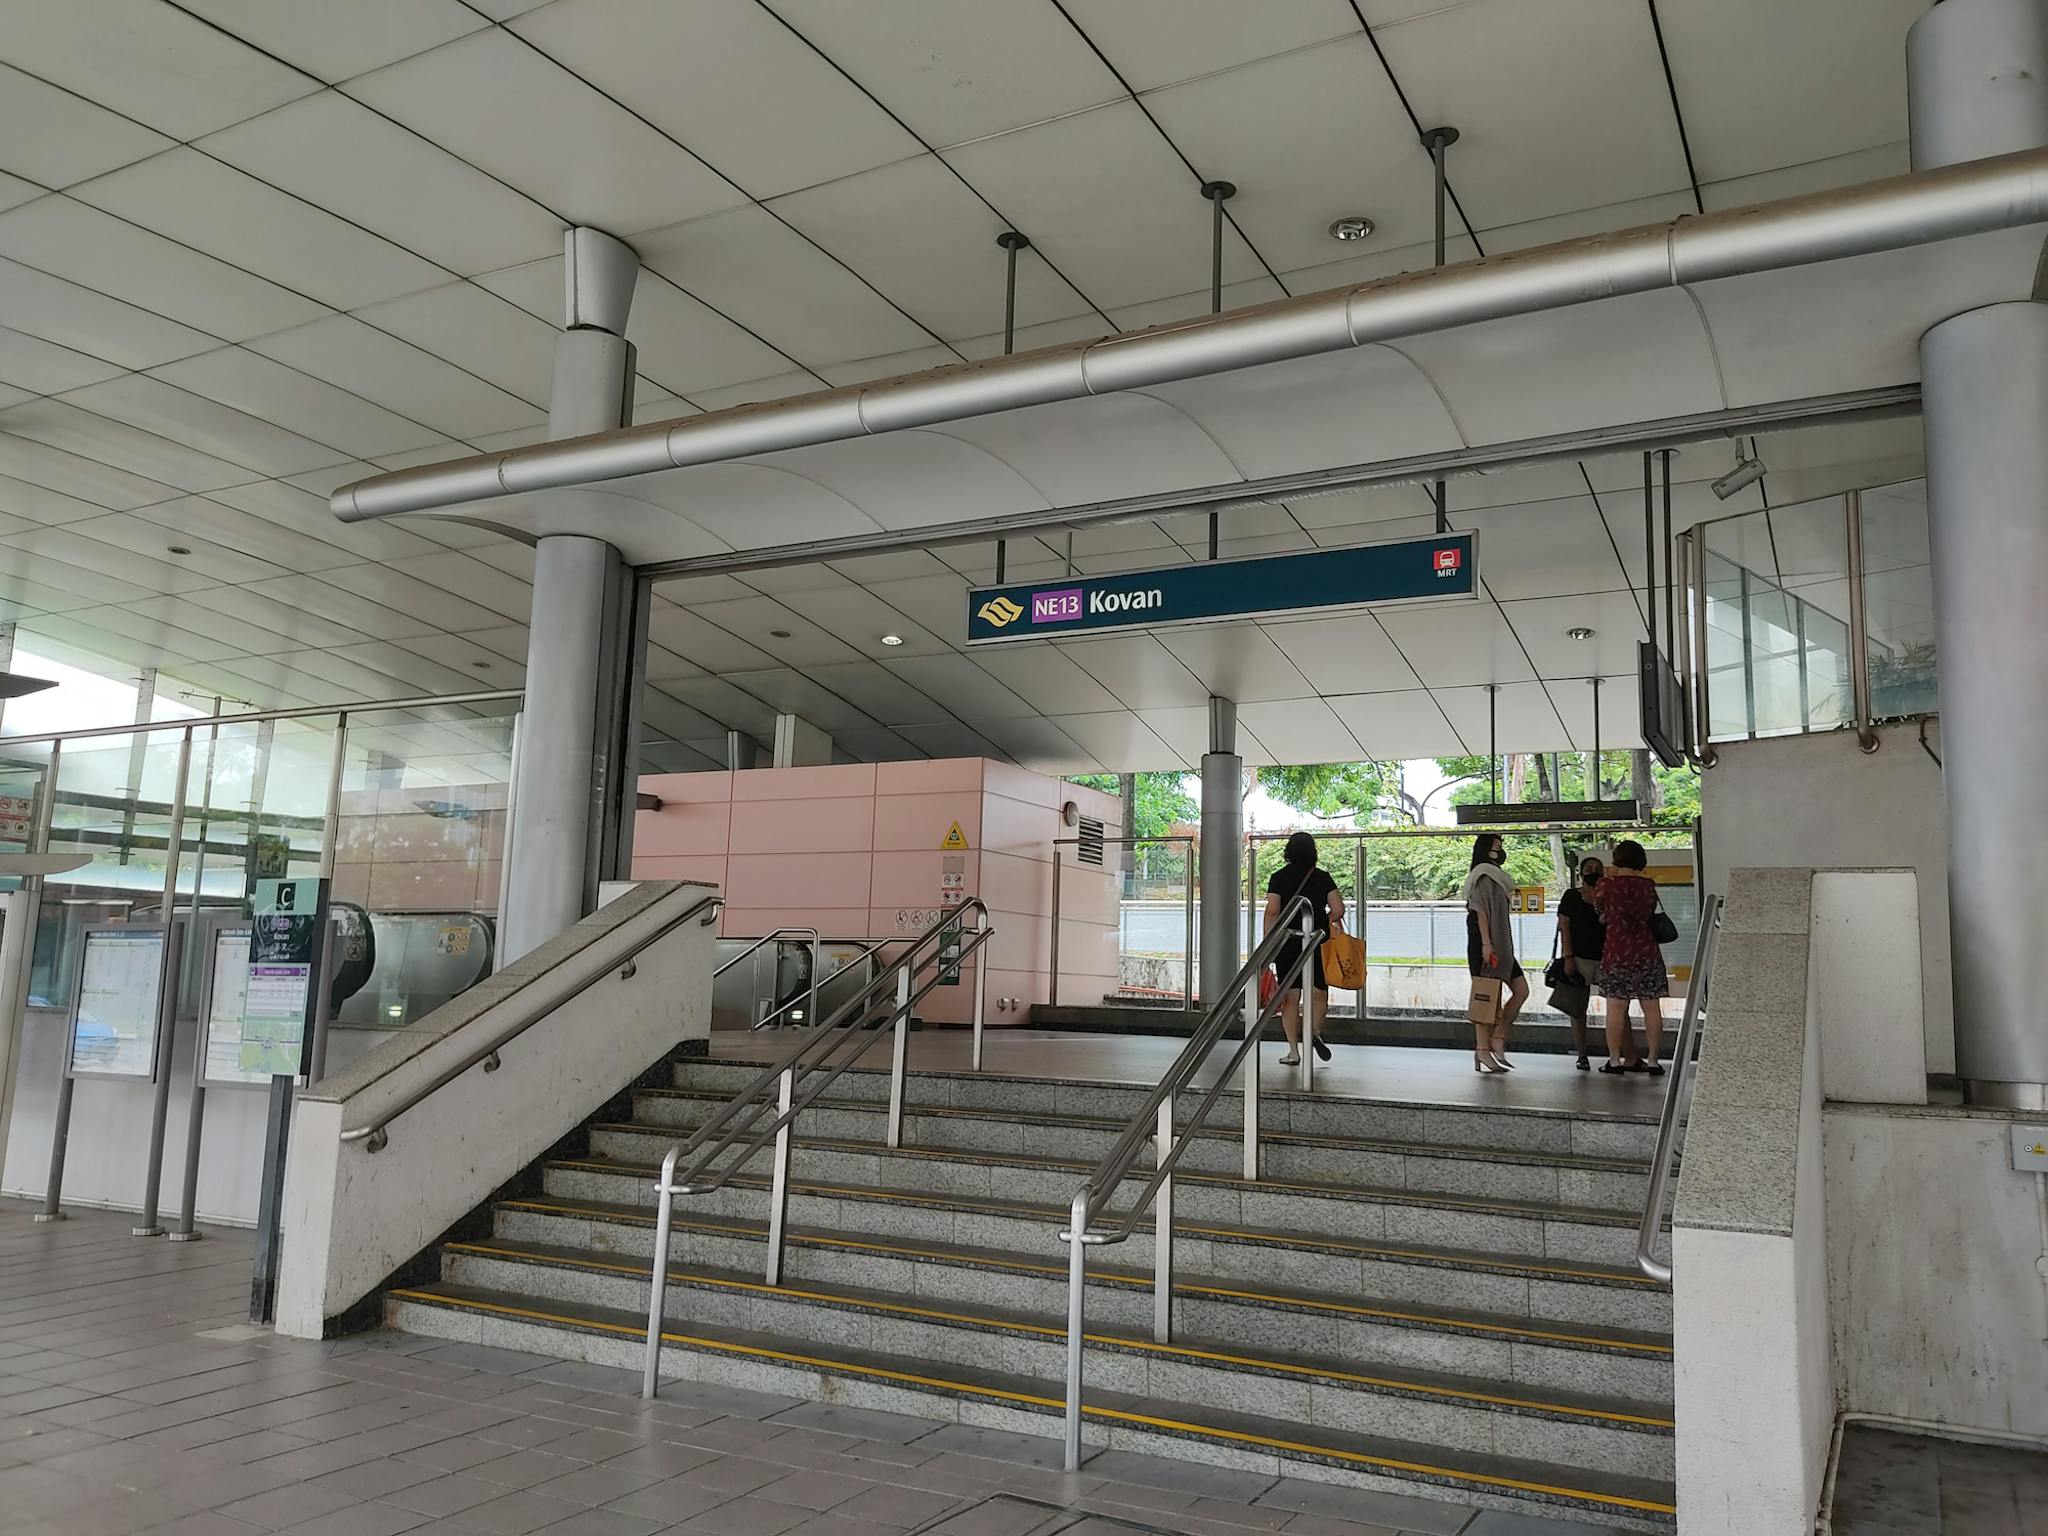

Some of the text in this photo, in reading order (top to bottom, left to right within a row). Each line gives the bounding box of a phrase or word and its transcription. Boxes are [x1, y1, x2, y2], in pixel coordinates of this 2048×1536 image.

[1437, 568, 1457, 578] MRT
[1035, 589, 1162, 617] NE13 Kovan
[281, 887, 292, 906] C
